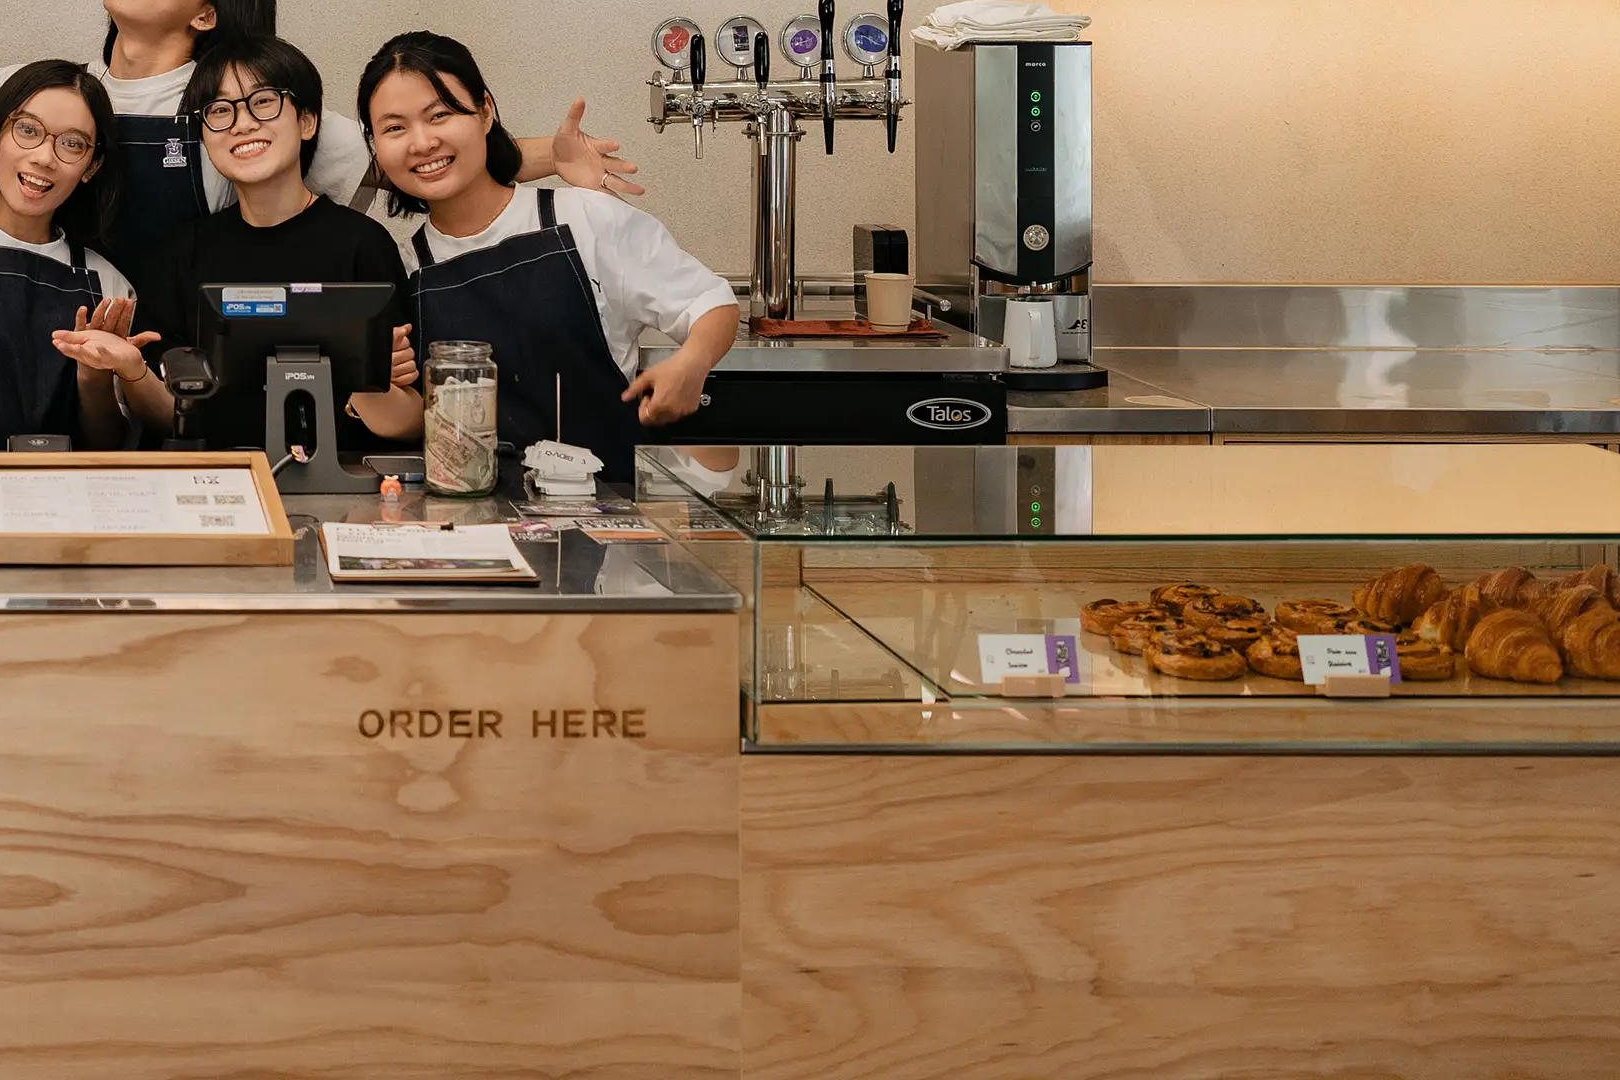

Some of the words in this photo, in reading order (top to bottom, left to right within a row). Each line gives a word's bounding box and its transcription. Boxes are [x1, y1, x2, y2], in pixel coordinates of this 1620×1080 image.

[926, 406, 972, 422] Talos
[358, 709, 504, 739] ORDER
[531, 709, 647, 739] HERE
